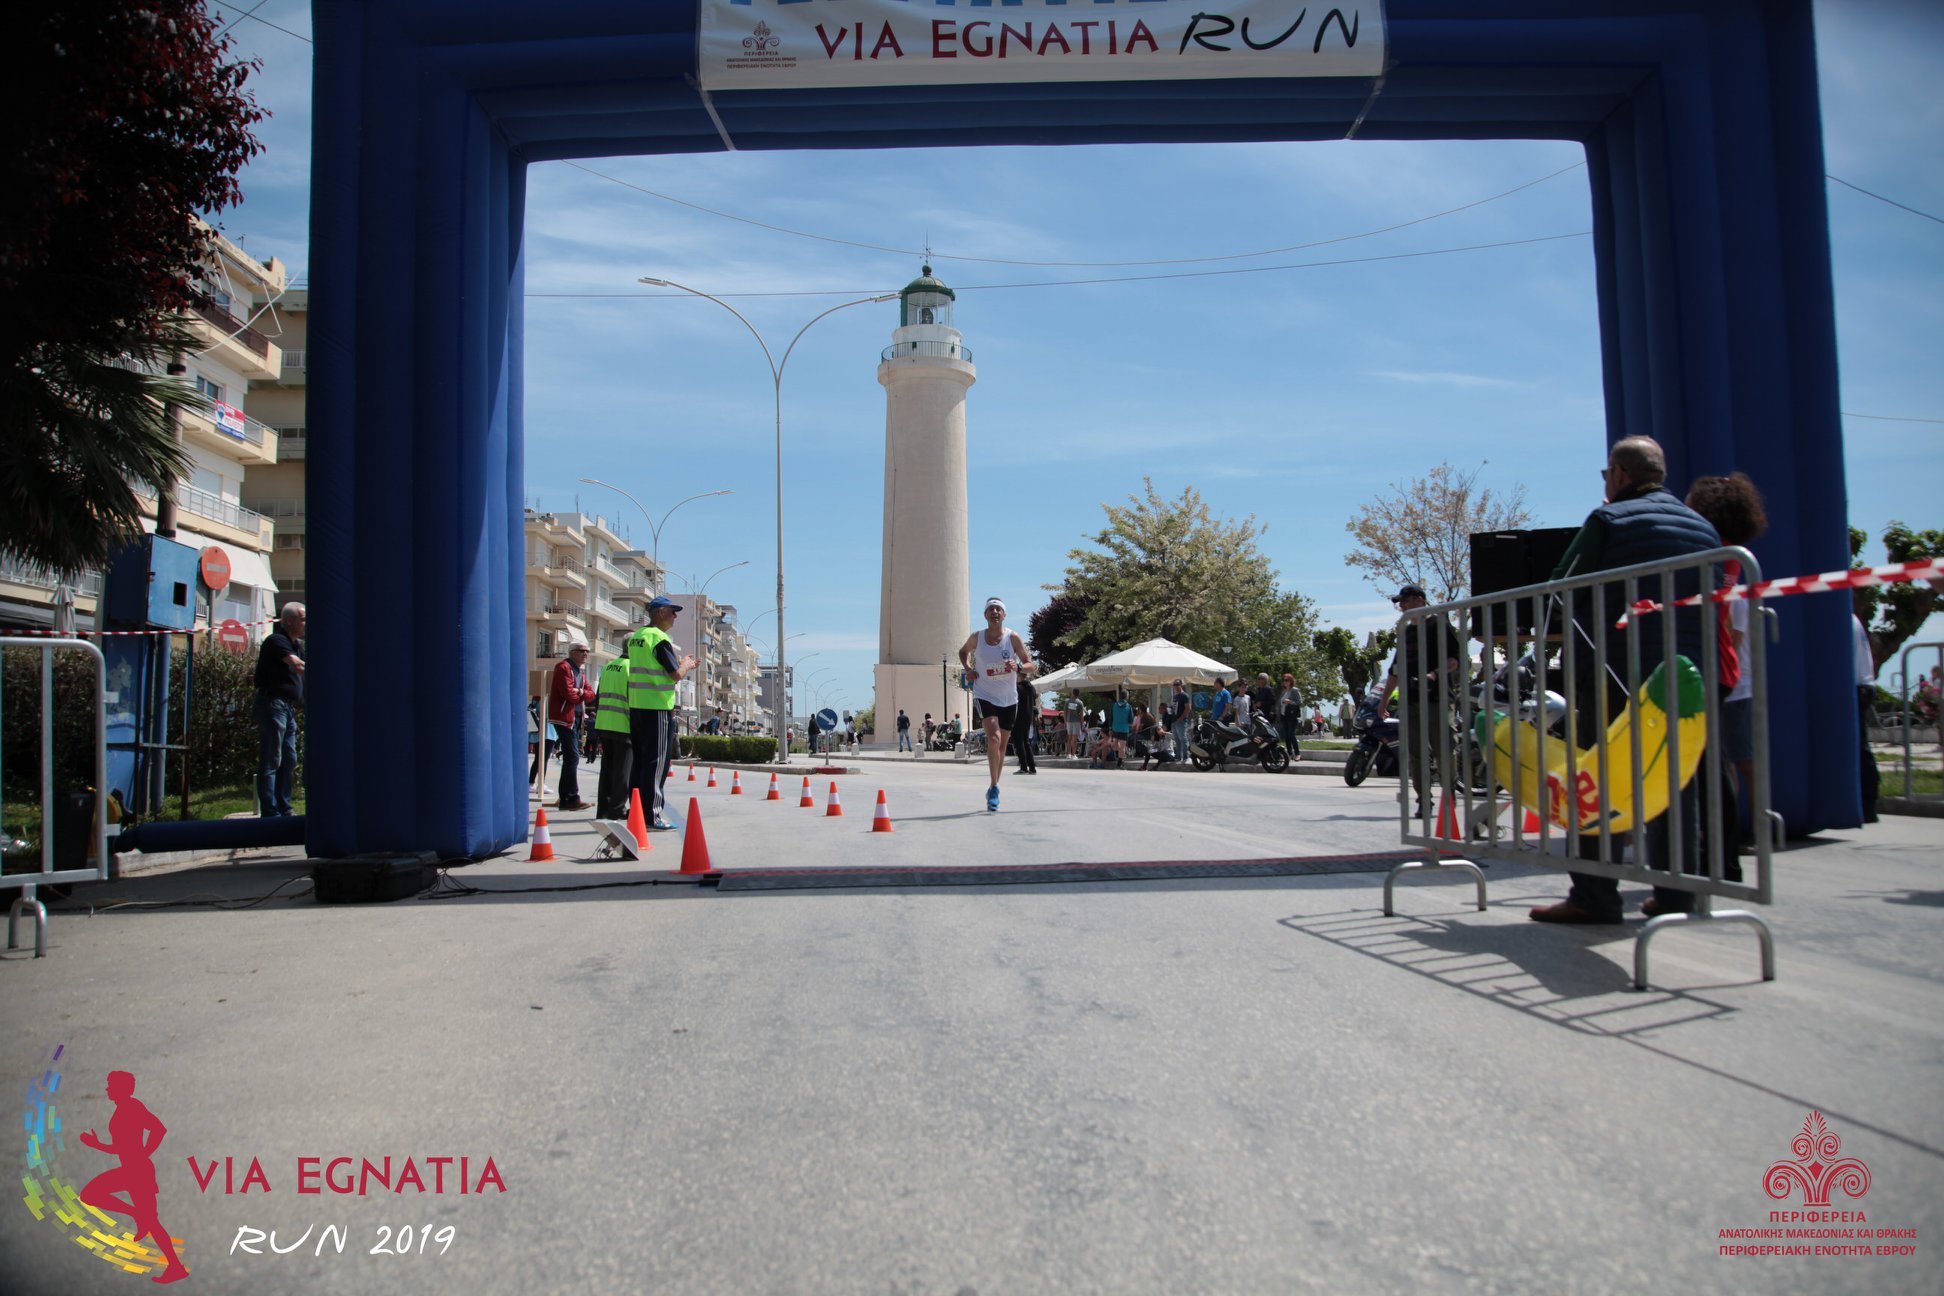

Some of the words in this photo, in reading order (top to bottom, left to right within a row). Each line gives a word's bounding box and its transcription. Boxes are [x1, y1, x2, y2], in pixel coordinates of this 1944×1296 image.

[815, 21, 904, 61] VIA
[931, 19, 1159, 59] EGNATIA
[1179, 7, 1359, 55] RUN
